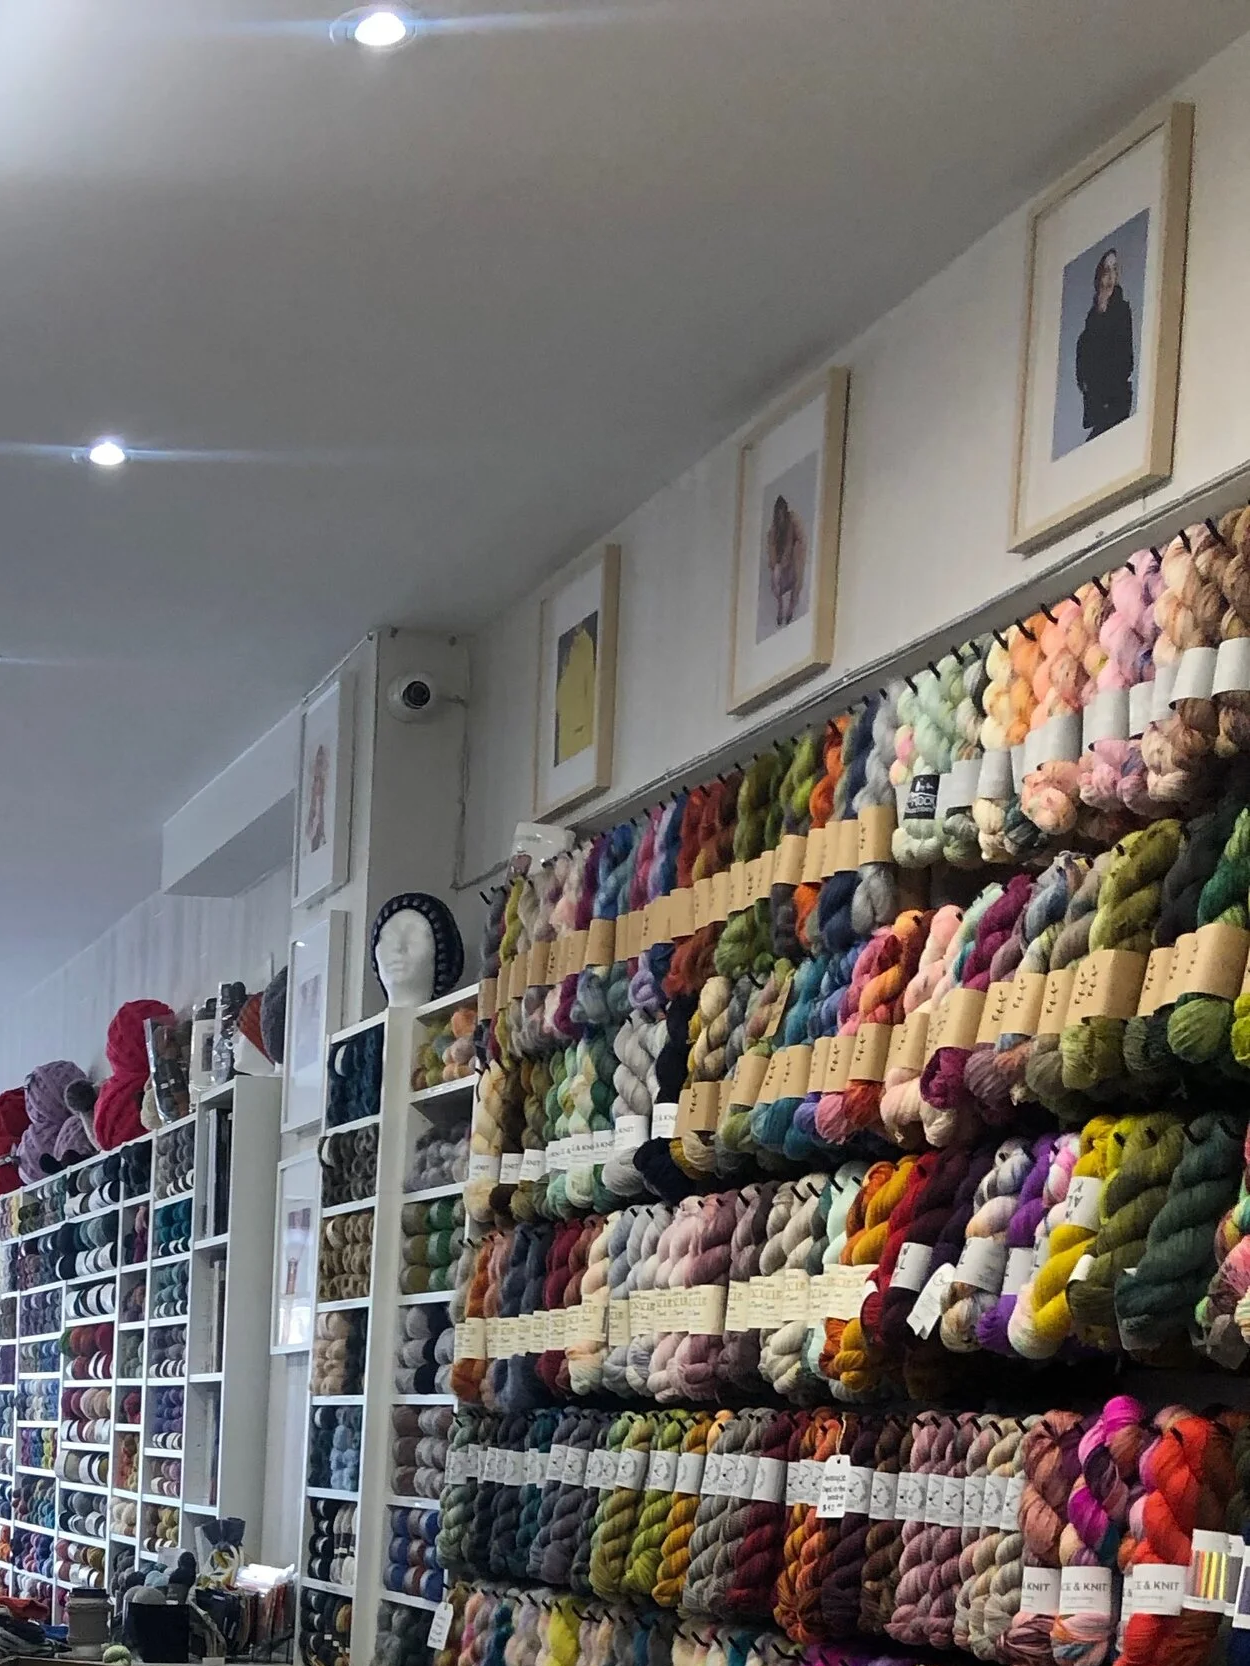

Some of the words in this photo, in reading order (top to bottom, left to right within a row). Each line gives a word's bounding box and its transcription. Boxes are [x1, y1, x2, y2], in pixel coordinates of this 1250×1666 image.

[1027, 1583, 1051, 1592] KNIT
[1083, 1583, 1110, 1591] KNIT
[1153, 1581, 1180, 1591] KNIT
